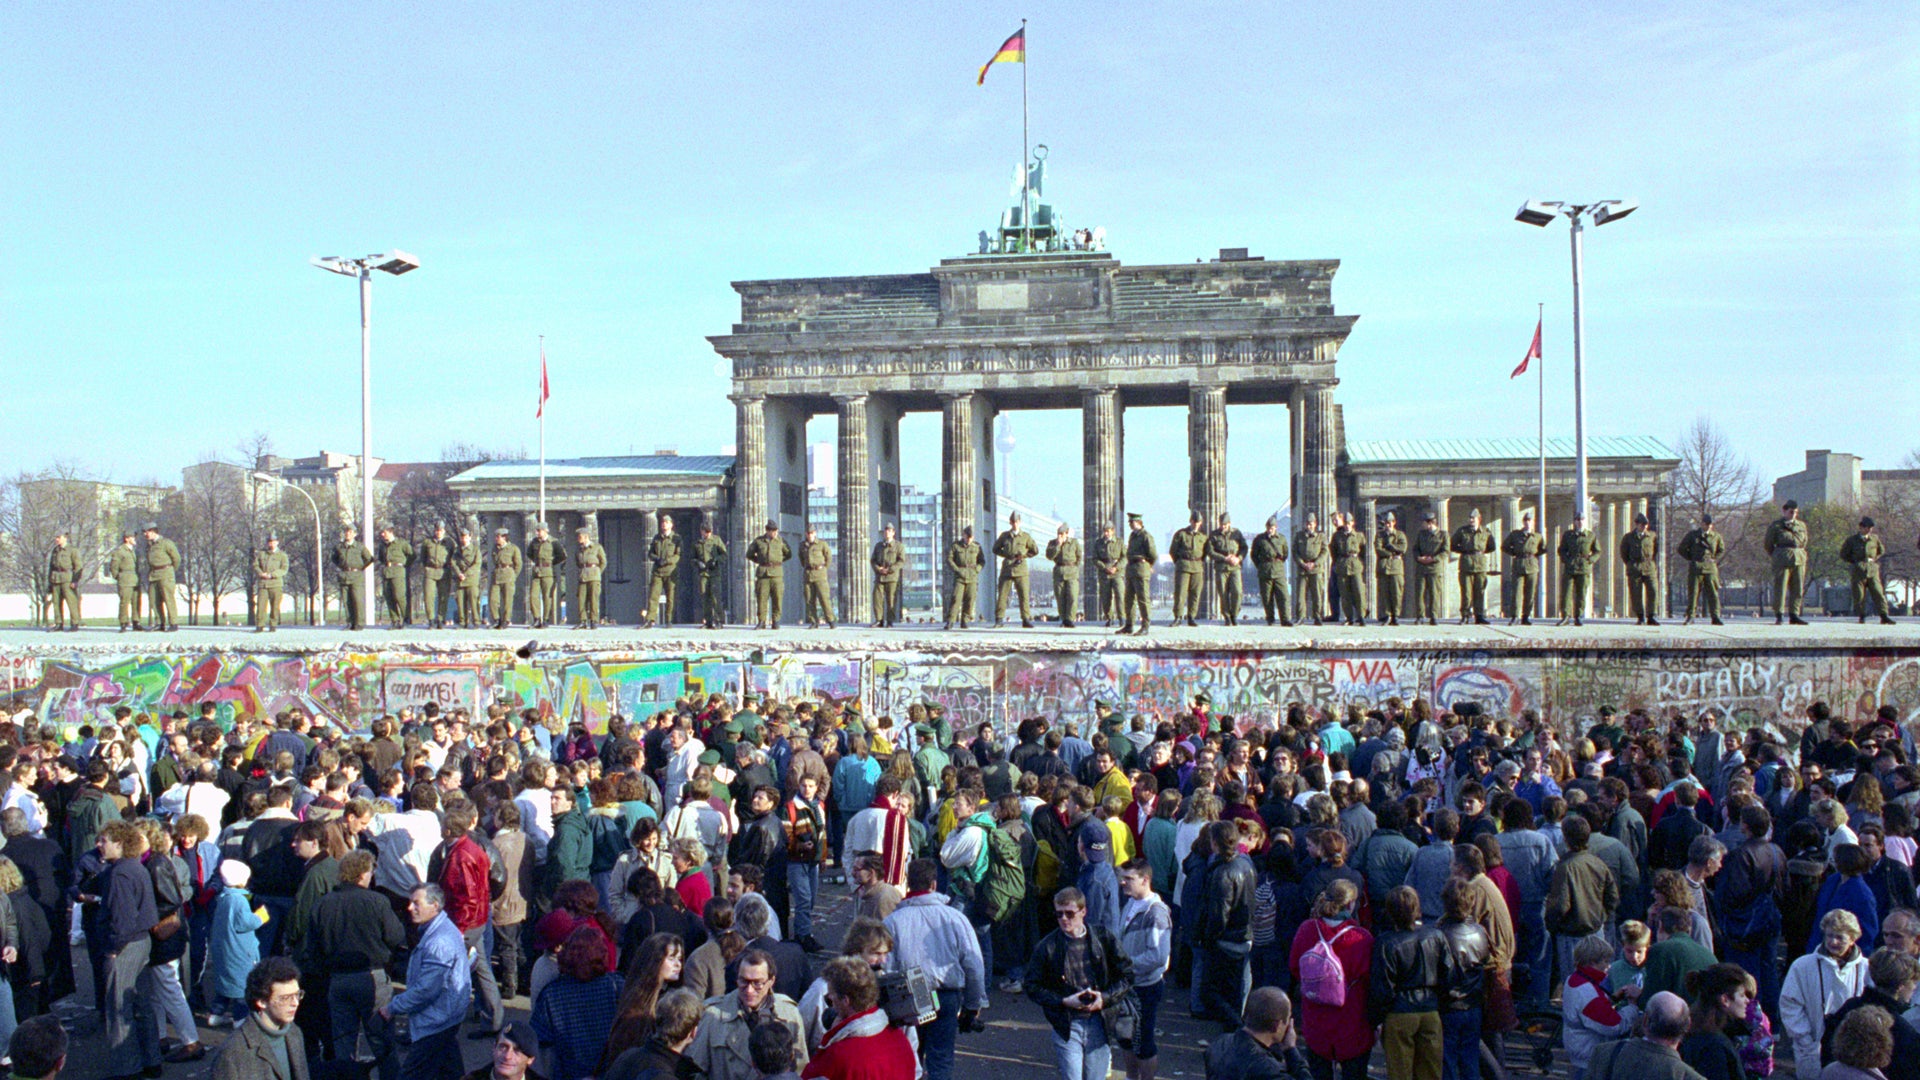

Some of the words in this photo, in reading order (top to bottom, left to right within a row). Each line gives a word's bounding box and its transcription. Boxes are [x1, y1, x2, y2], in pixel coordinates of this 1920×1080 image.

[1261, 667, 1306, 682] DAVID
[1320, 657, 1396, 685] TWA
[1656, 662, 1776, 700] ROTARY
